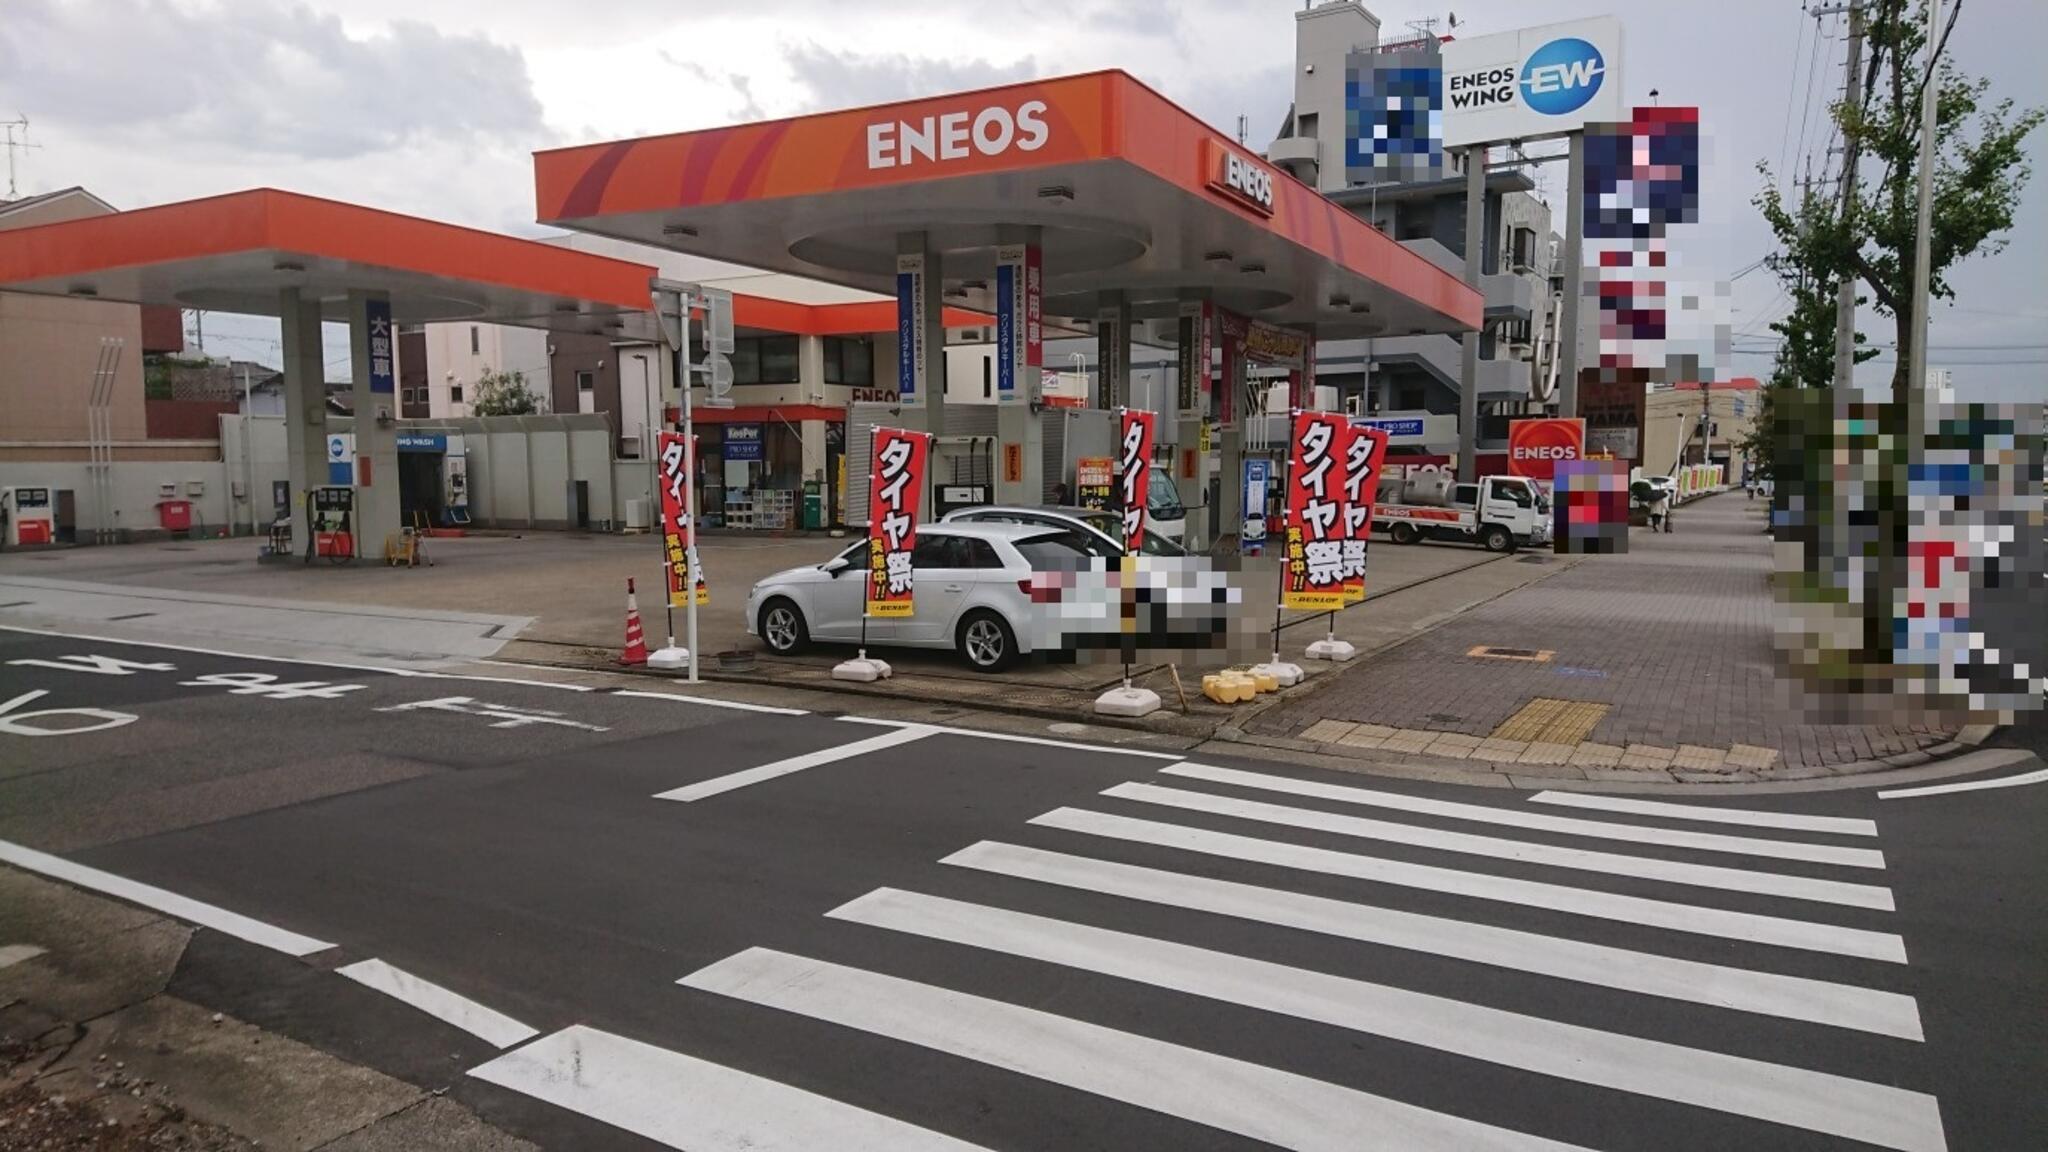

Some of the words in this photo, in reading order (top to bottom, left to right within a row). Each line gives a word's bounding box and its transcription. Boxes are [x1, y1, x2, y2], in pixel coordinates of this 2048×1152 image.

[1450, 66, 1514, 91] ENEOS
[1530, 58, 1598, 94] EW
[1450, 85, 1514, 109] WING
[866, 101, 1049, 169] ENEOS
[1225, 152, 1273, 206] ENEOS
[1027, 266, 1040, 347] 乗用車
[371, 316, 391, 378] 大型車
[852, 388, 900, 402] ENEO
[1513, 446, 1576, 460] ENEOS
[879, 438, 913, 593] タイヤ祭
[1301, 422, 1344, 586] タイヤ祭
[1383, 508, 1410, 517] ENEOS
[1297, 596, 1339, 604] DUNLOP
